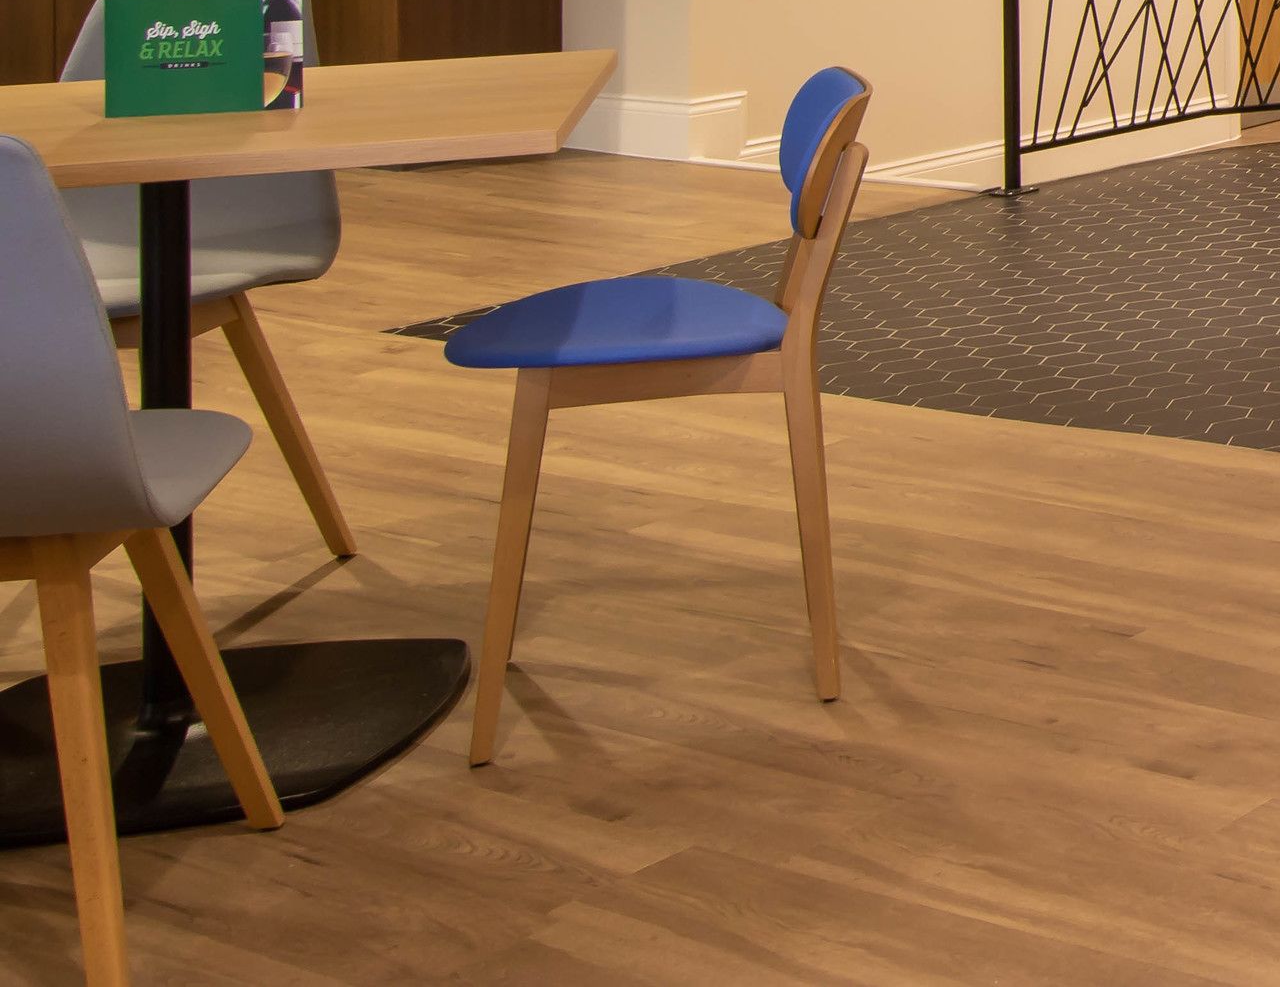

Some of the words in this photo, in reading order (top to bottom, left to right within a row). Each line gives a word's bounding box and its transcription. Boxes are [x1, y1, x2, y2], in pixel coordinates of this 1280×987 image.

[146, 21, 179, 40] Sip,
[182, 20, 221, 39] Sigh
[140, 42, 155, 59] &
[158, 39, 223, 59] RELAX
